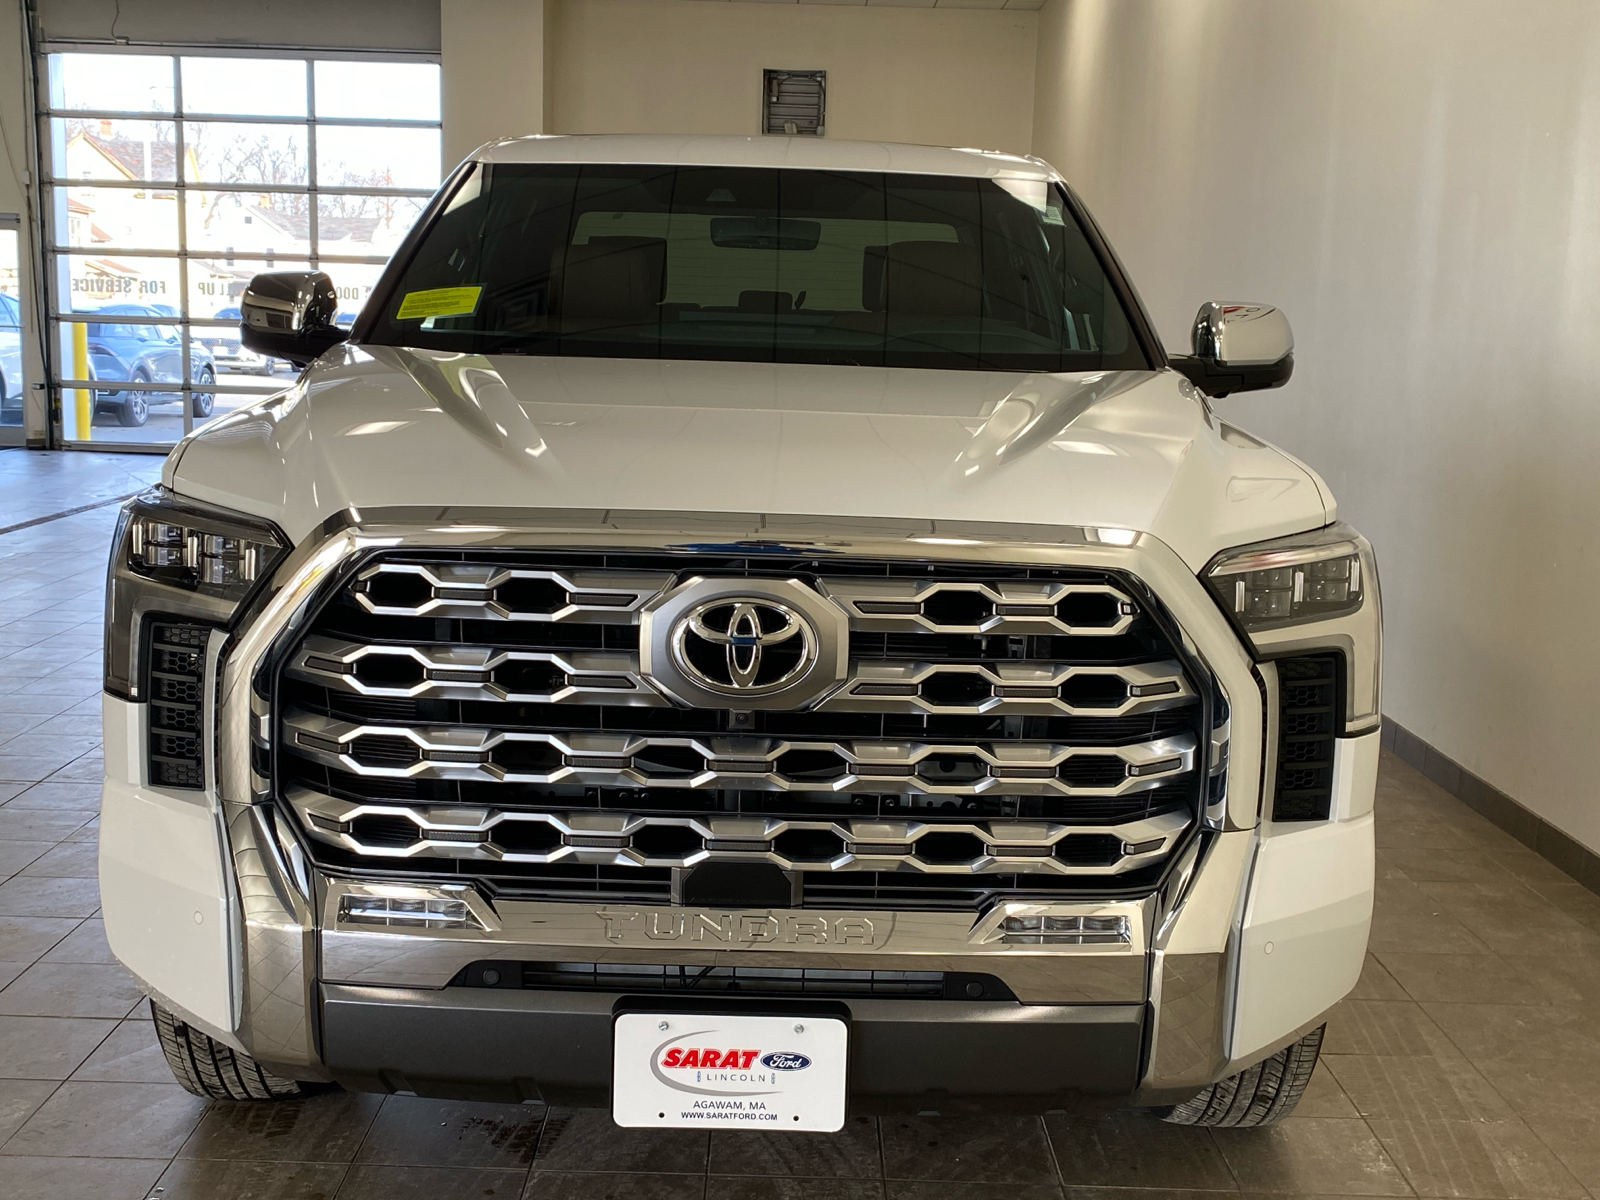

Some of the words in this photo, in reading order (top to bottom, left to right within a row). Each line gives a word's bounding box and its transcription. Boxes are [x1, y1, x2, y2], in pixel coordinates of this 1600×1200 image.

[596, 911, 875, 945] TUNDRA
[661, 1047, 761, 1070] SARAT
[769, 1053, 803, 1069] Ford
[706, 1073, 766, 1083] LINCOLN
[693, 1100, 746, 1111] AGAWAM,
[749, 1101, 767, 1111] MA
[681, 1111, 778, 1121] WWW.SARATFORD.COM
